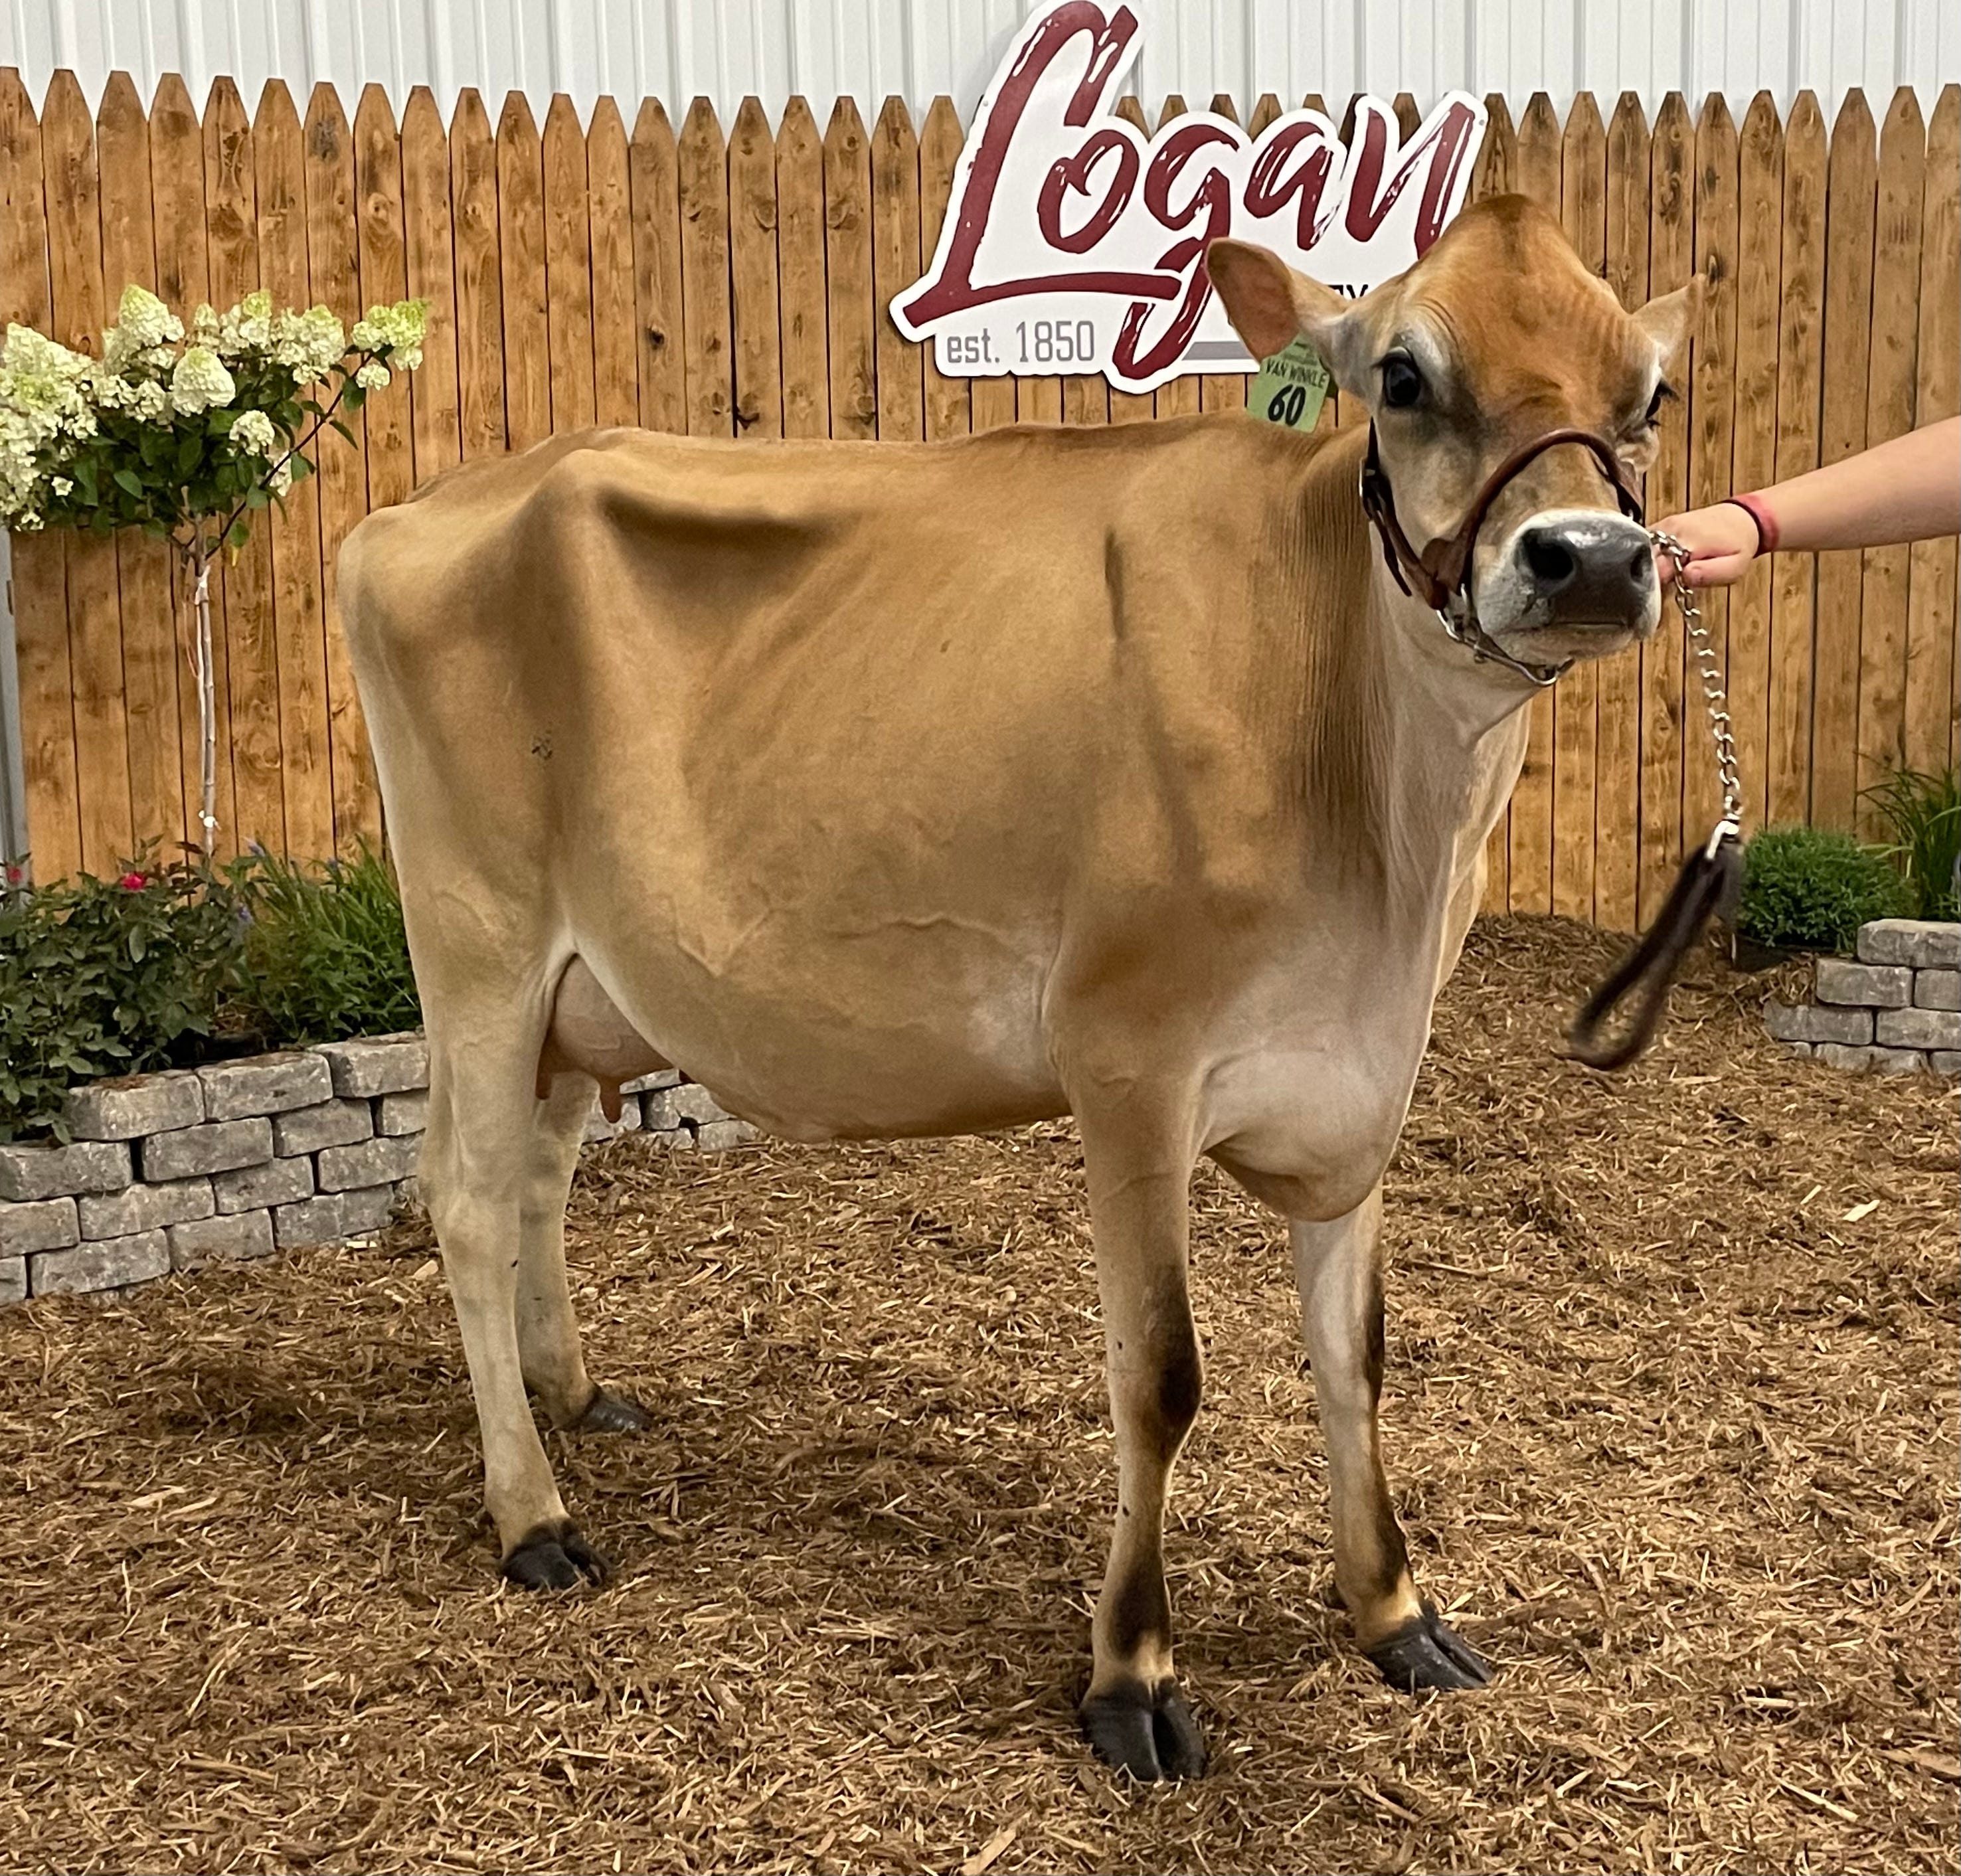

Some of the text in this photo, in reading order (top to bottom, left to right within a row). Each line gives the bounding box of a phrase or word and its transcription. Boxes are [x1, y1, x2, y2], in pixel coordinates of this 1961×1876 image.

[904, 1, 1476, 379] Logan
[947, 321, 1094, 363] est. 1850
[1266, 359, 1288, 378] VAN
[1268, 384, 1306, 426] 60
